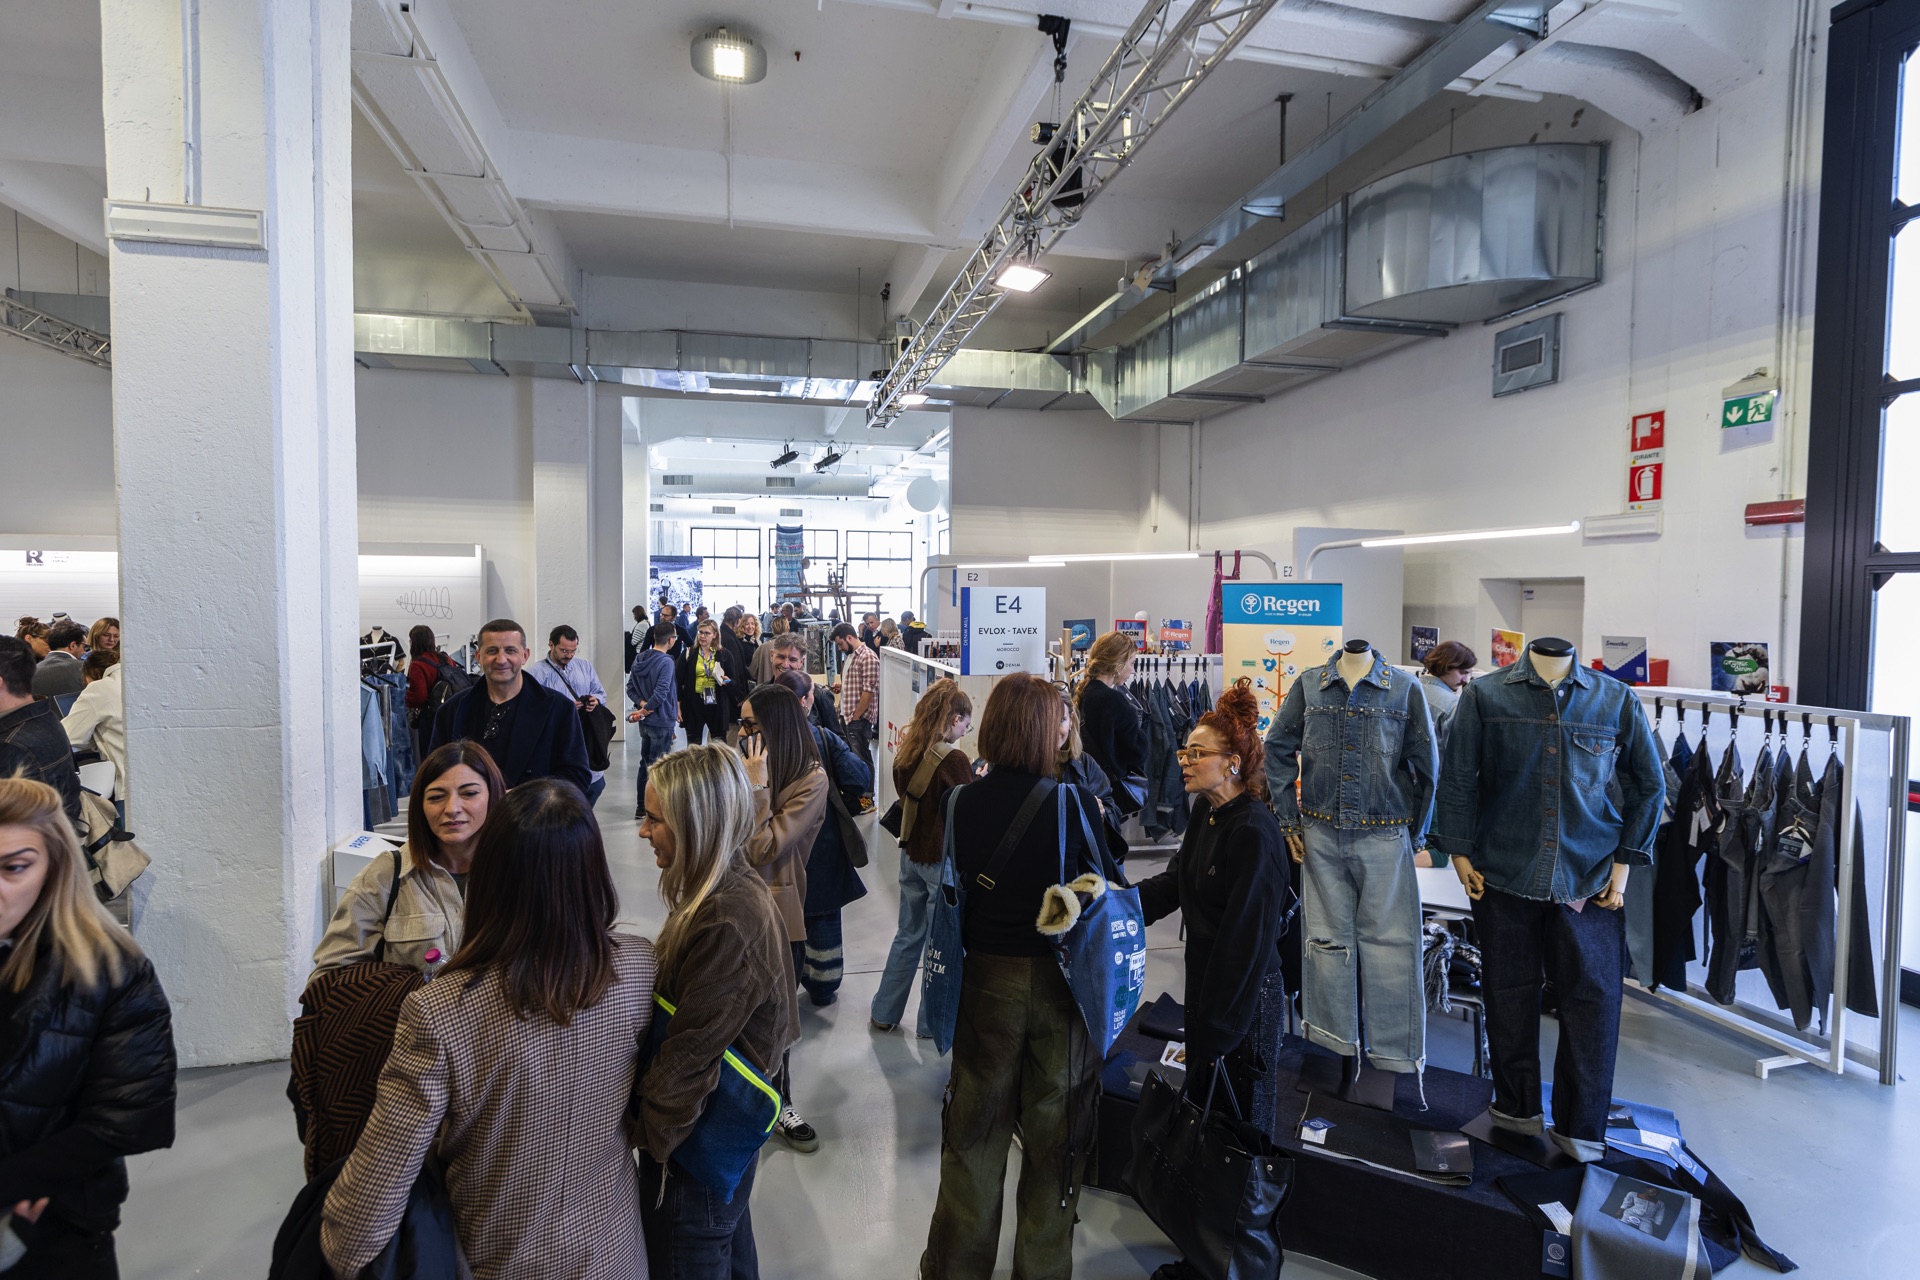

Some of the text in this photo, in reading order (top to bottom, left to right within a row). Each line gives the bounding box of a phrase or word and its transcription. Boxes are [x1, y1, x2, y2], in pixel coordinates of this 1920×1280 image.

[967, 572, 979, 581] E2
[1283, 566, 1293, 577] E2
[995, 595, 1022, 614] E4
[1263, 595, 1321, 615] Regen
[978, 627, 1006, 635] EVLOX
[1012, 627, 1038, 635] TAVEX
[1170, 631, 1189, 639] Regen
[1116, 992, 1128, 1002] ECO
